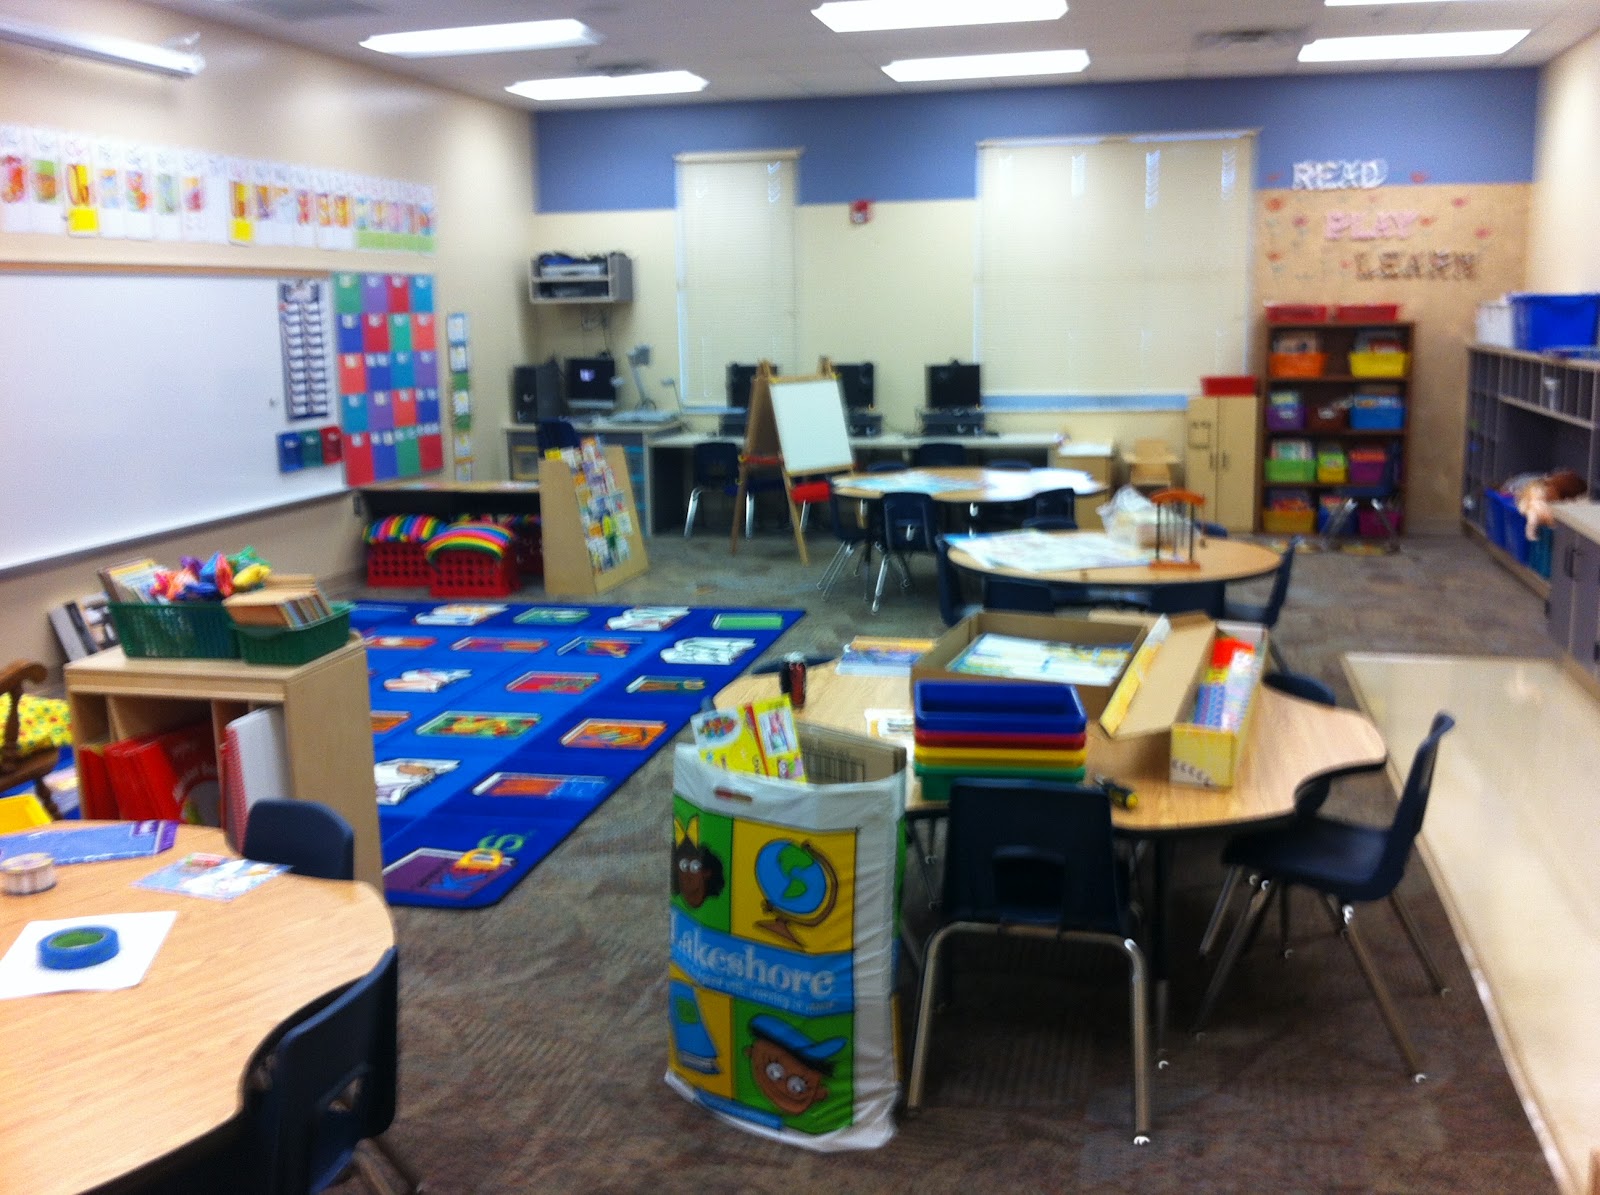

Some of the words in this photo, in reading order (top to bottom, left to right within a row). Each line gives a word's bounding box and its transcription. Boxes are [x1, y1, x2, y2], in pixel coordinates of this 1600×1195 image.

[1292, 160, 1388, 190] READ
[1324, 210, 1419, 241] PLAY
[1353, 250, 1478, 281] LEARN
